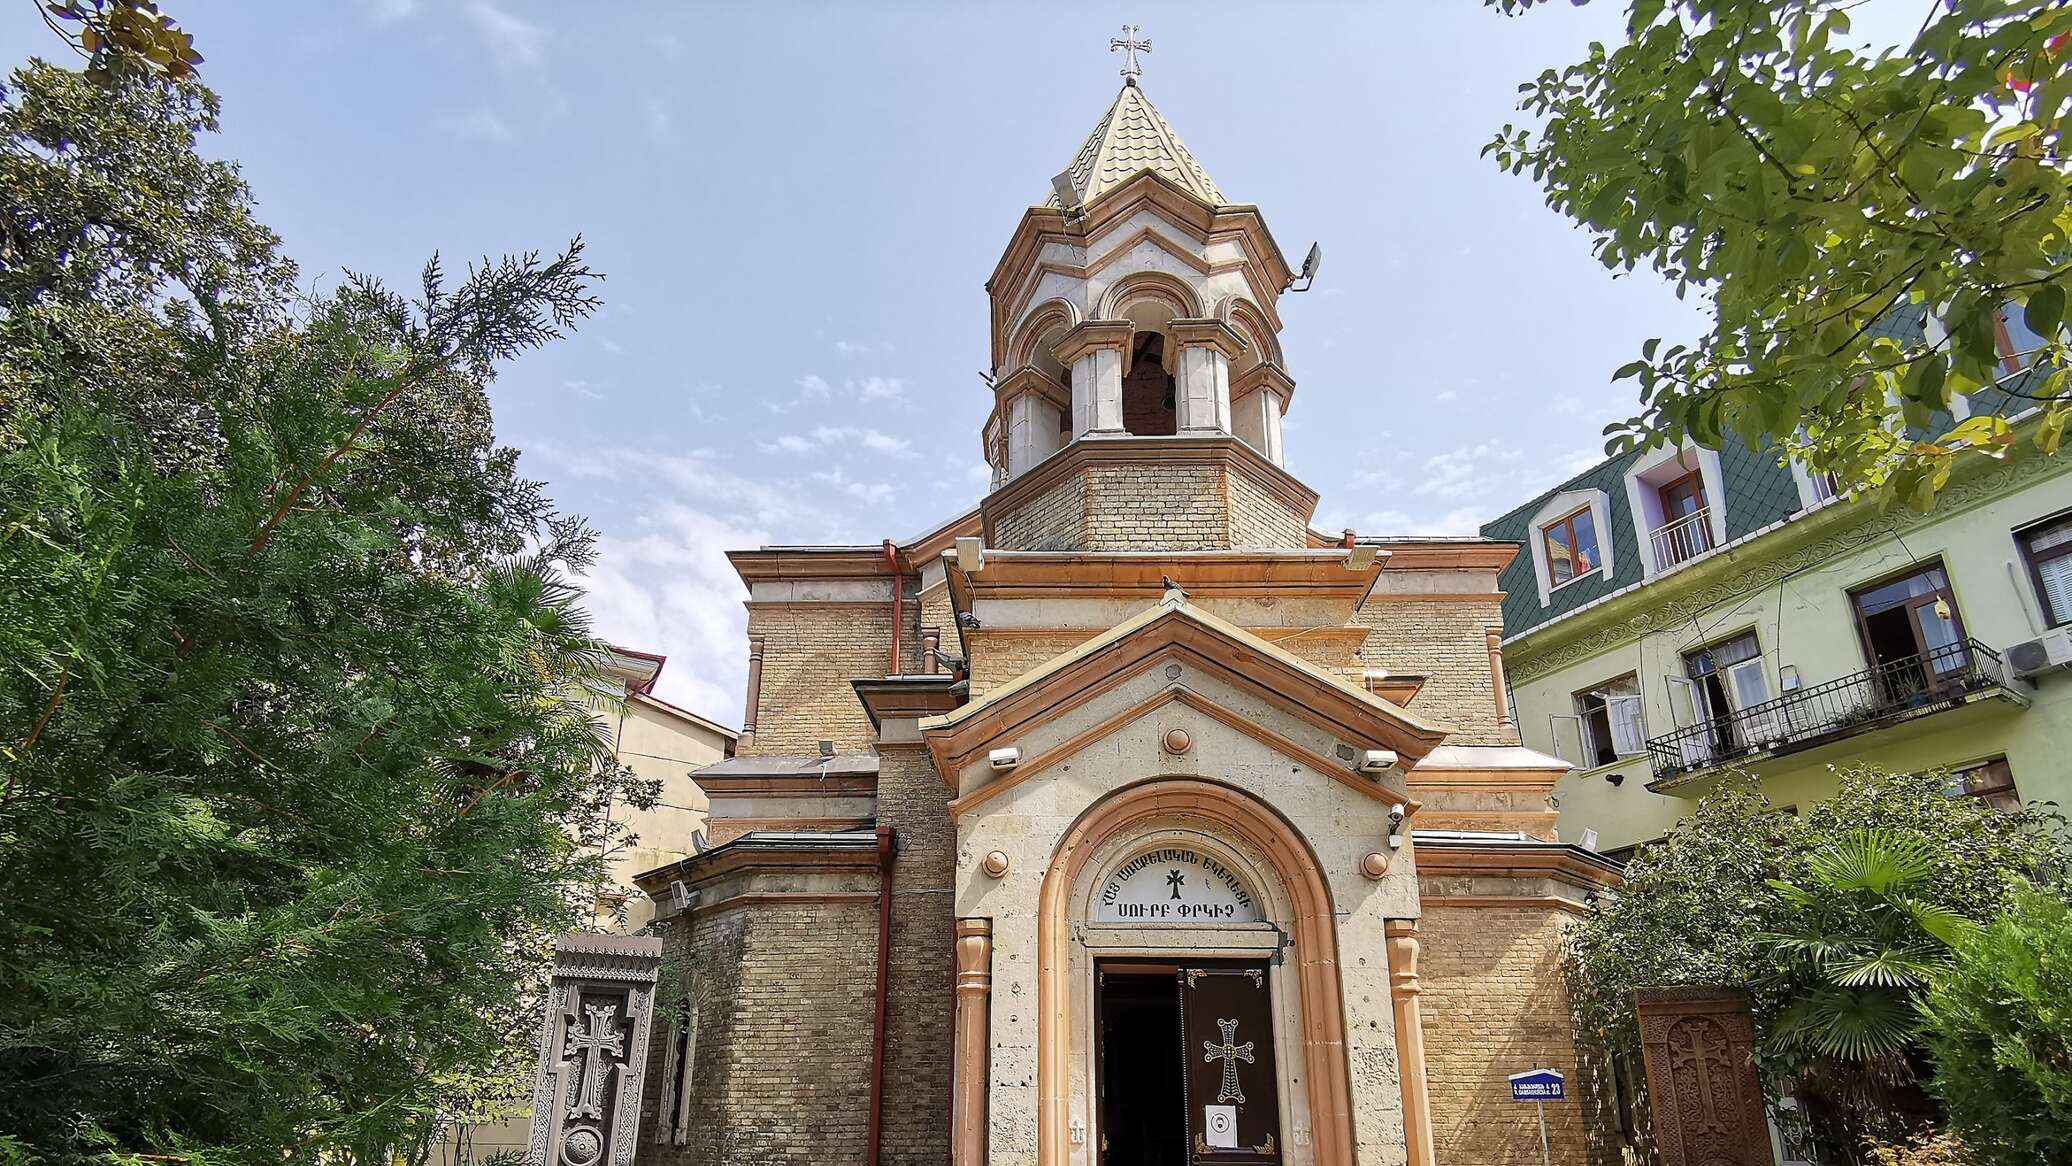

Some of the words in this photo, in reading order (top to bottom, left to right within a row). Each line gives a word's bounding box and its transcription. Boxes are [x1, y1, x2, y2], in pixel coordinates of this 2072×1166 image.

[1118, 903, 1170, 918] ՍՈՒՐԲ
[1177, 903, 1235, 918] ՓՐԿԻՉ
[1551, 1083, 1561, 1095] 23
